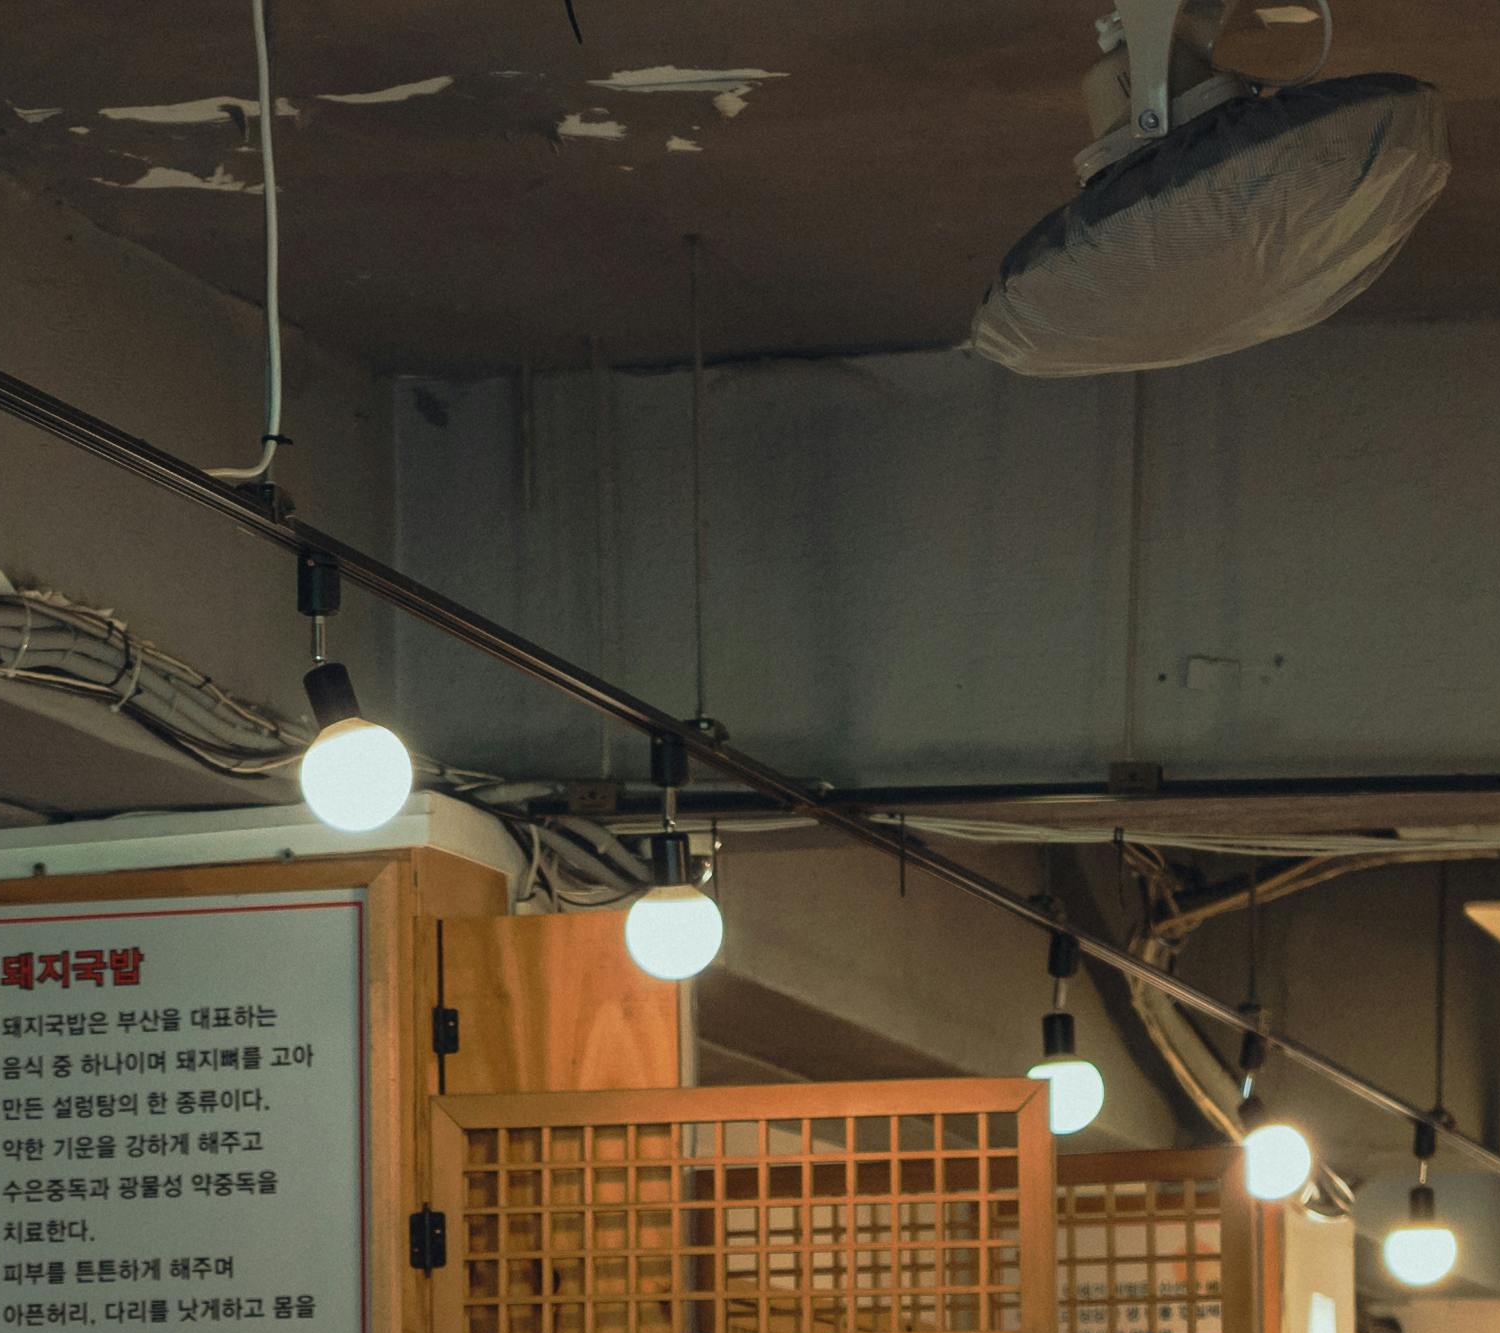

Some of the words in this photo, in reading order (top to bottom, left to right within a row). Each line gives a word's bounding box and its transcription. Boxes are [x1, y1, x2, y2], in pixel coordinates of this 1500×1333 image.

[0, 946, 145, 990] 돼지국밥
[2, 1012, 109, 1038] 돼지국밥은
[117, 1007, 182, 1033] 부산을
[191, 1004, 278, 1030] 대표하는
[2, 1055, 44, 1080] 음식
[52, 1055, 72, 1079] 중
[80, 1050, 167, 1077] 하나이며
[176, 1045, 263, 1072] 돼지뼈를
[270, 1043, 314, 1068] 고아
[2, 1096, 44, 1121] 만든
[147, 1091, 168, 1116] 한
[176, 1088, 271, 1114] 종류이다.
[2, 1138, 44, 1162] 약한
[53, 1135, 116, 1161] 기운을
[125, 1132, 190, 1158] 강하게
[198, 1130, 264, 1156] 해주고
[2, 1177, 110, 1203] 수은중독과
[118, 1174, 184, 1200] 광물성
[191, 1170, 278, 1197] 약중독을
[3, 1219, 96, 1245] 치료한다.
[3, 1261, 66, 1285] 피부를
[75, 1257, 162, 1284] 튼튼하게
[169, 1255, 234, 1281] 해주며
[104, 1300, 169, 1324] 다리를
[273, 1294, 316, 1319] 몸을
